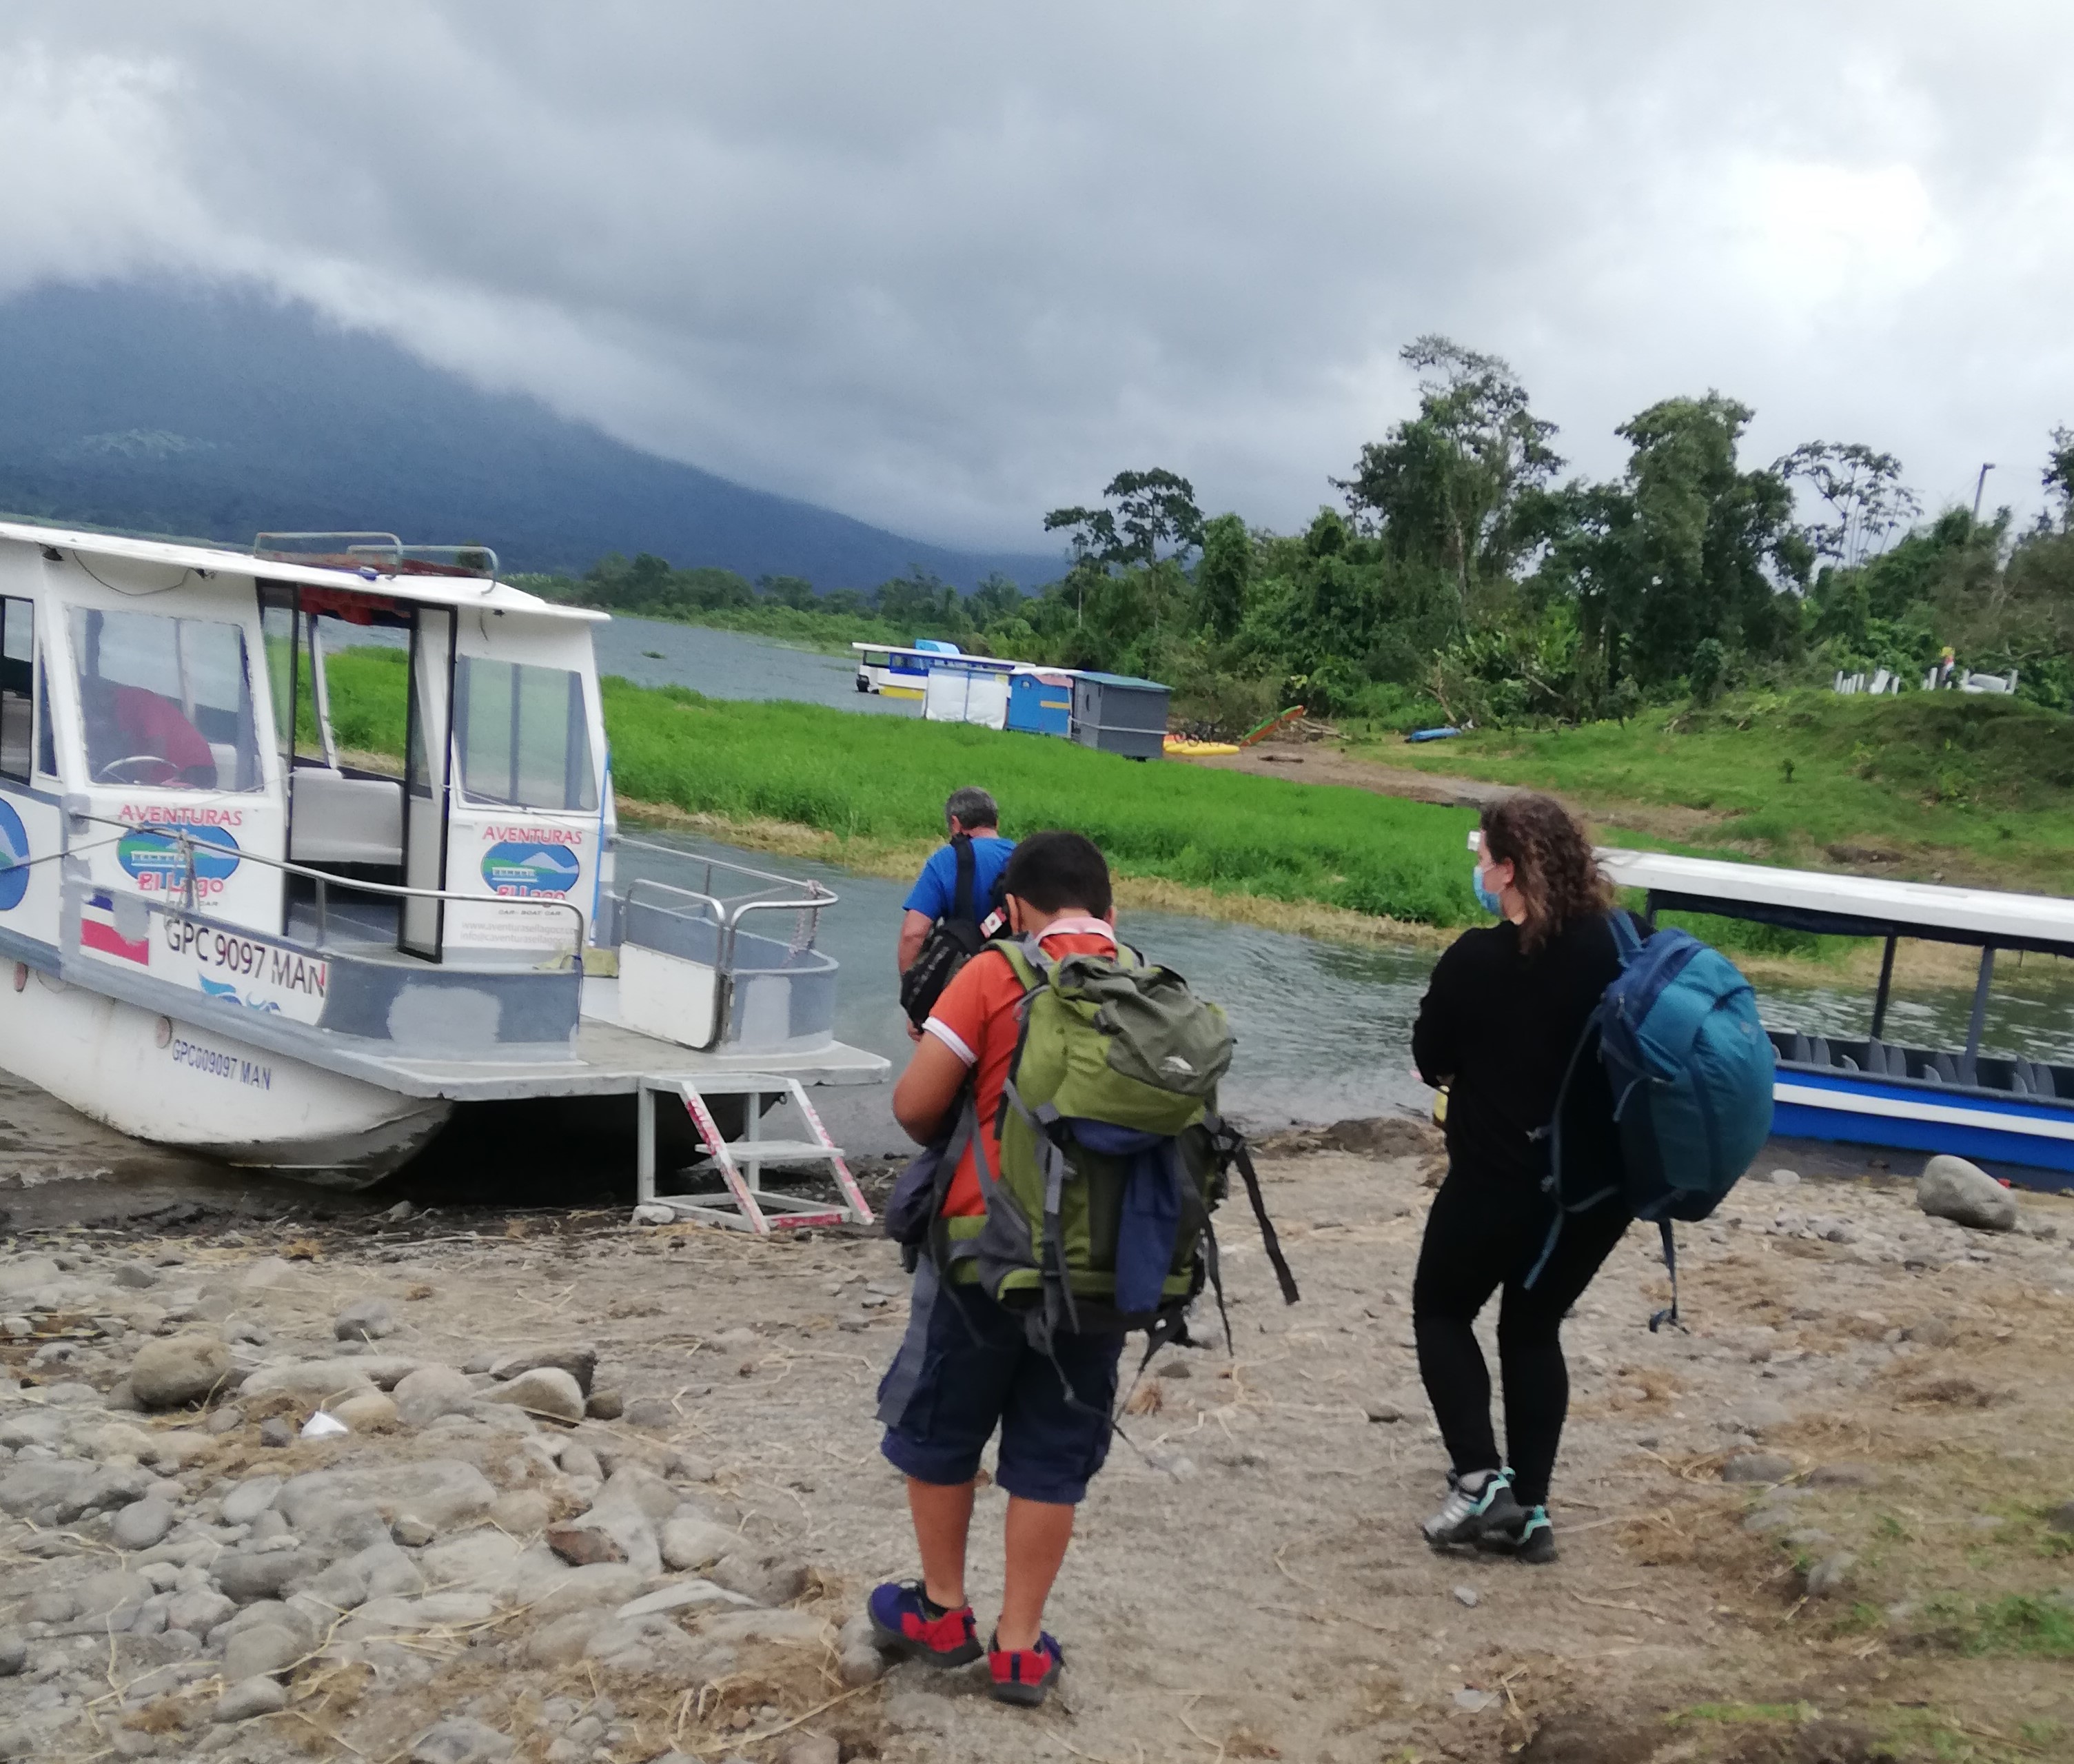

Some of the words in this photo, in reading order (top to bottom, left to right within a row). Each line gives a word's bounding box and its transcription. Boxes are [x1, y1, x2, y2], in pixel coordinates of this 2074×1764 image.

[119, 804, 243, 826] AVENTURAS
[482, 827, 582, 845] AVENTURAS
[169, 873, 225, 898] Lgo
[166, 918, 210, 961] GPC
[214, 934, 265, 979] 9097
[271, 949, 326, 998] MAN
[240, 1060, 272, 1091] MAN
